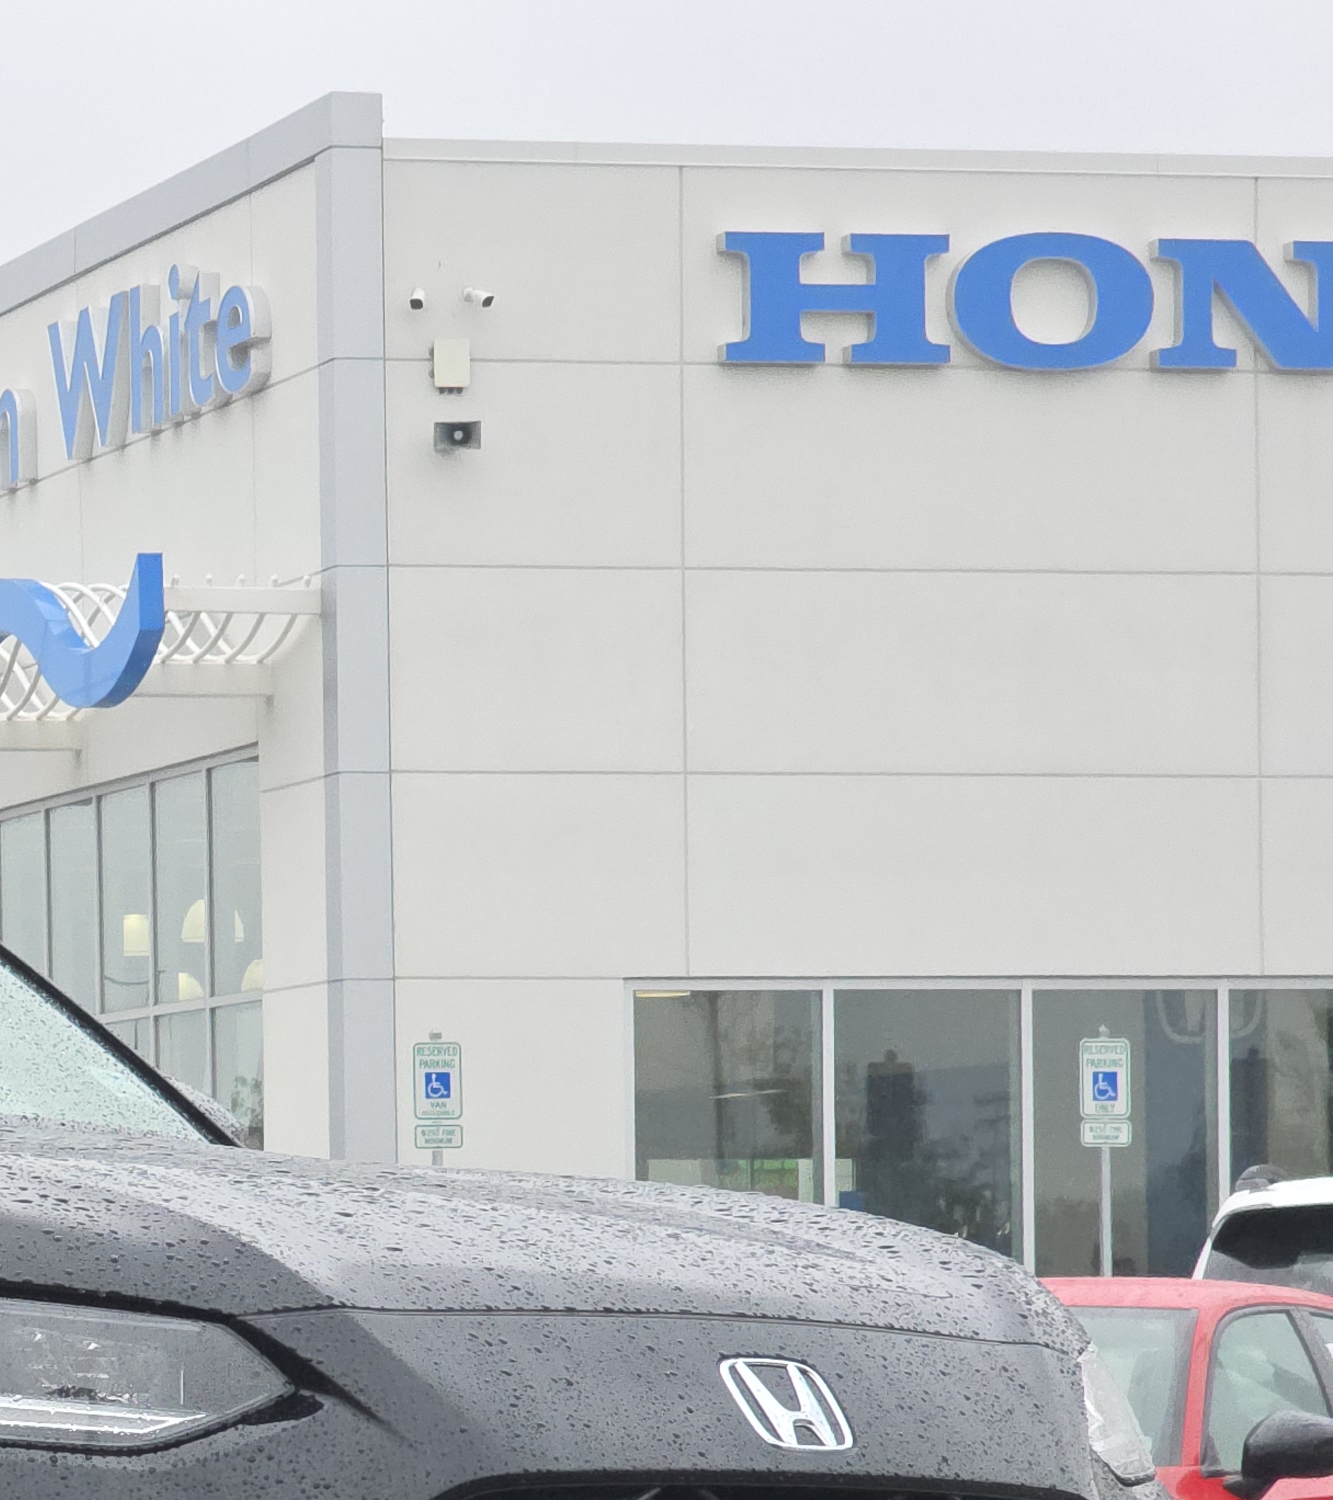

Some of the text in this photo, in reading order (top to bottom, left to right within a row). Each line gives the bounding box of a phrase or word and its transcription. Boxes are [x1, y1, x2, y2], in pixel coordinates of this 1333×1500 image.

[717, 231, 1333, 370] HON
[47, 263, 271, 461] White
[416, 1046, 458, 1057] RESERVED
[1083, 1044, 1126, 1055] RESERVED
[418, 1059, 456, 1069] PARKING
[1085, 1058, 1124, 1068] PARKING
[429, 1101, 447, 1109] VAN
